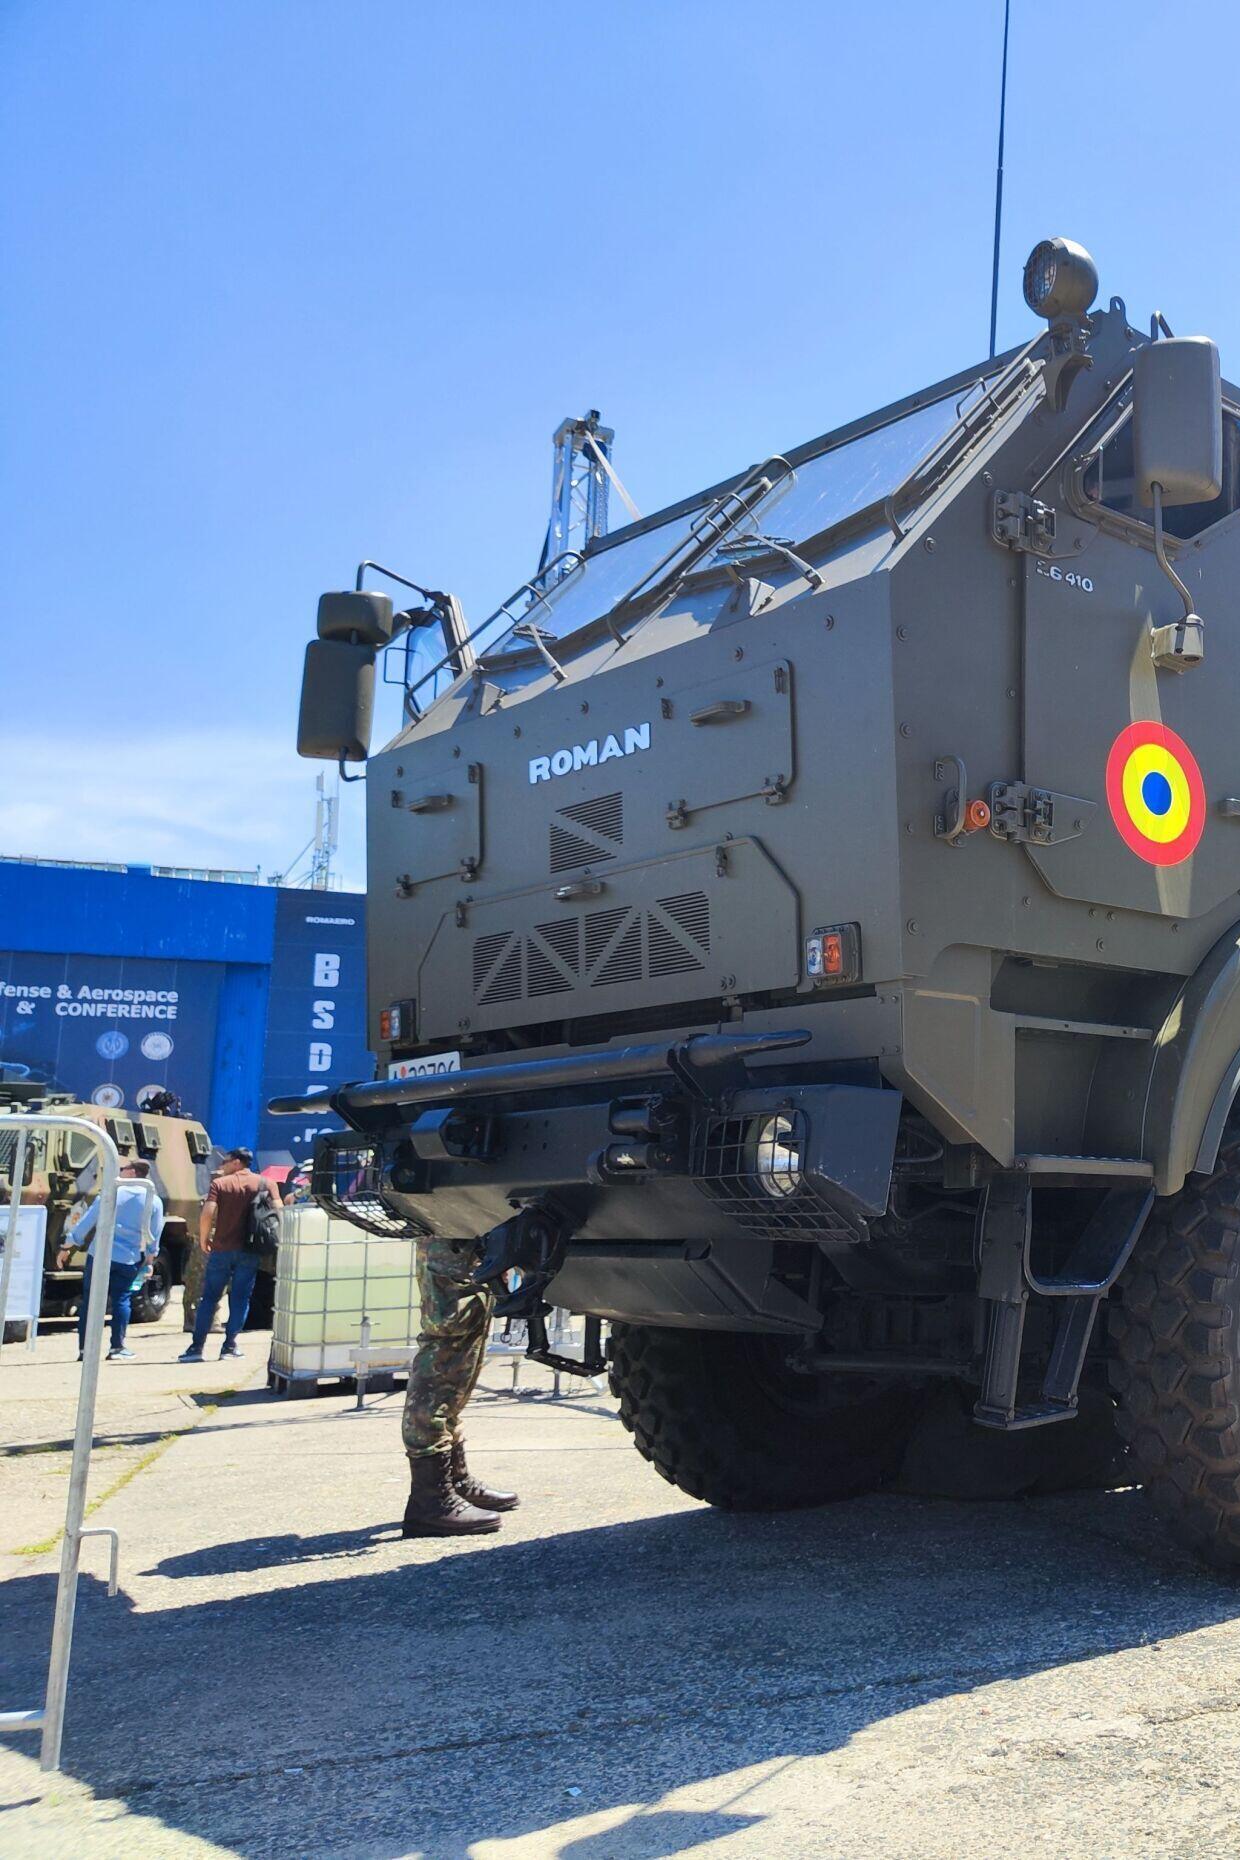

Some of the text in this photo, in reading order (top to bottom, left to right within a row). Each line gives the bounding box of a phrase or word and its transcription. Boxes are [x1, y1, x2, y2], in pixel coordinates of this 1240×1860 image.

[528, 722, 650, 784] ROMAN
[57, 984, 73, 1000] &
[77, 985, 179, 1004] Aerospace
[16, 1001, 178, 1020] & CONFERENCE
